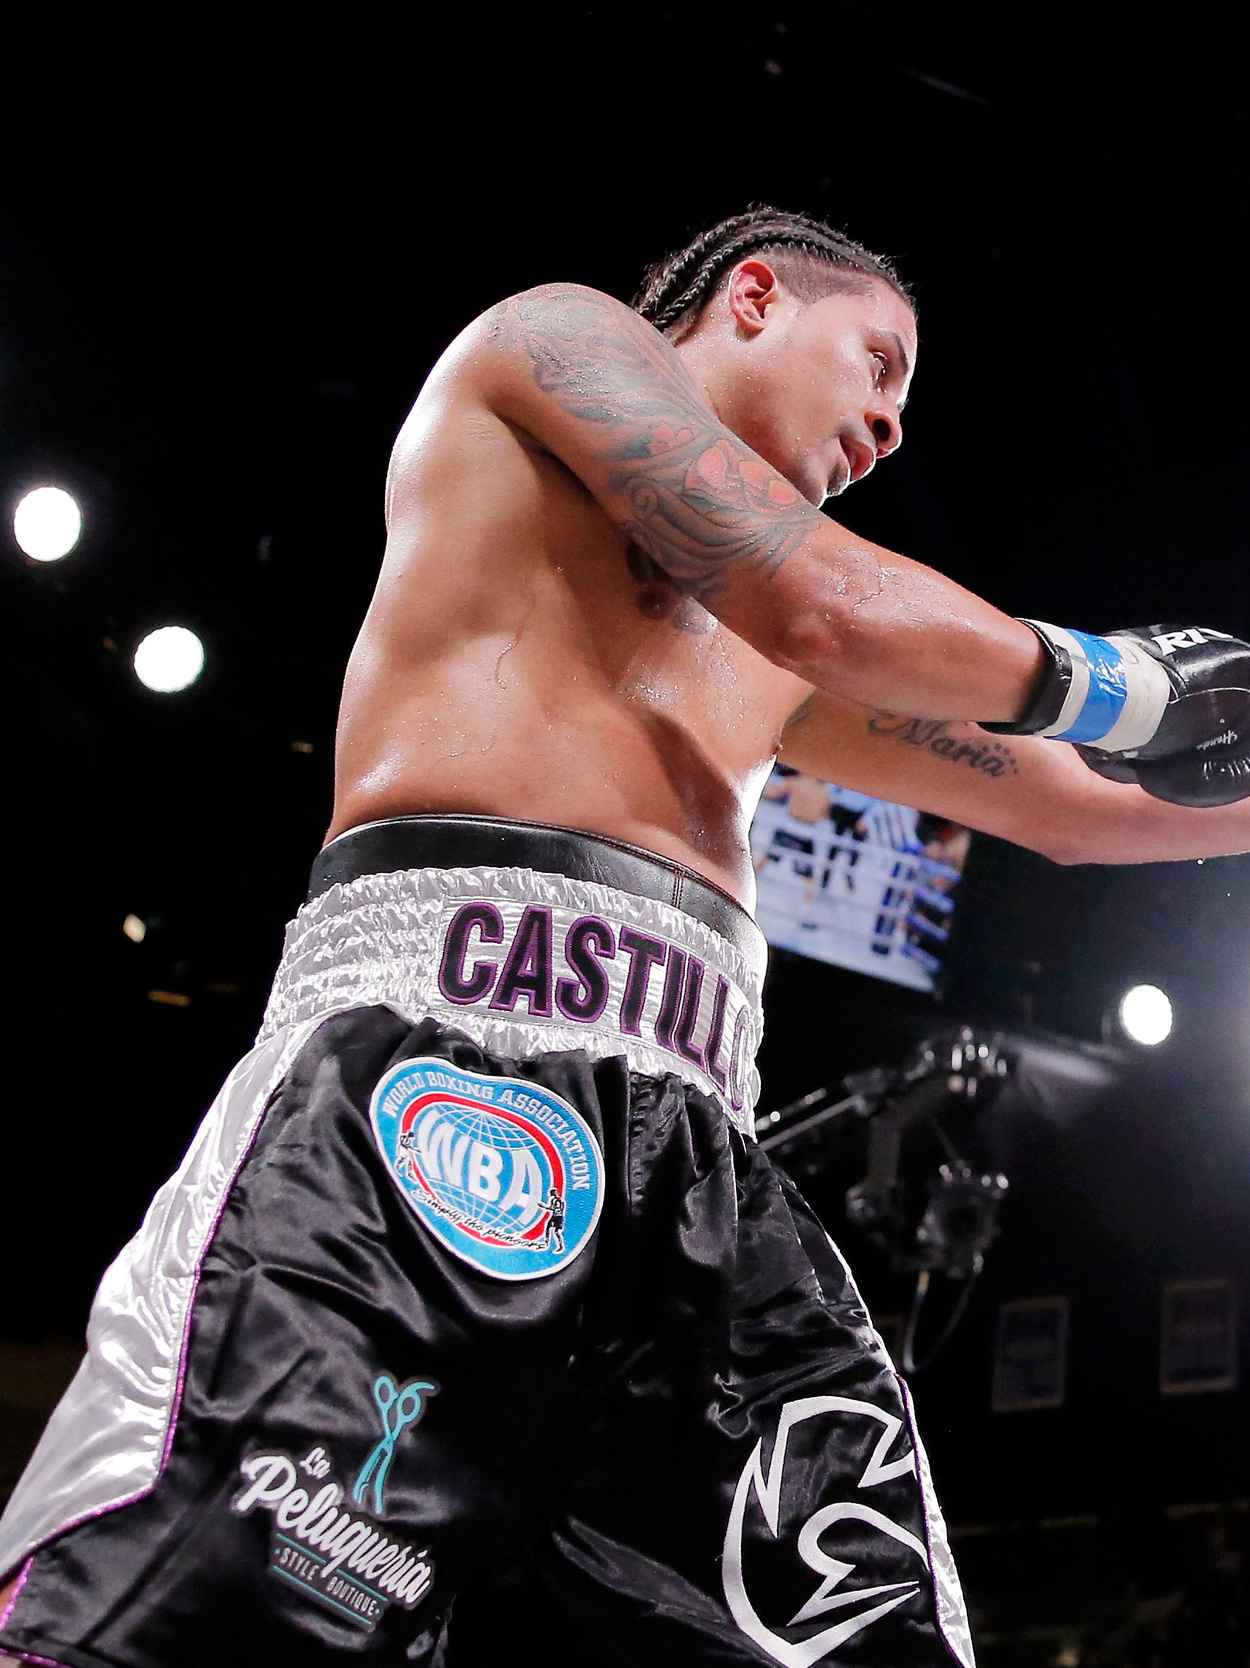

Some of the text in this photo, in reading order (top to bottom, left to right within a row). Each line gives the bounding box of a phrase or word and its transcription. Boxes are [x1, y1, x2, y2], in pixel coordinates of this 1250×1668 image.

[437, 901, 749, 1111] CASTILLO
[381, 1070, 591, 1191] WORLD BOXING ASSOCIATION
[416, 1108, 543, 1225] WBA
[299, 1446, 331, 1479] La
[279, 1546, 378, 1616] STYLE BOUTIQUE
